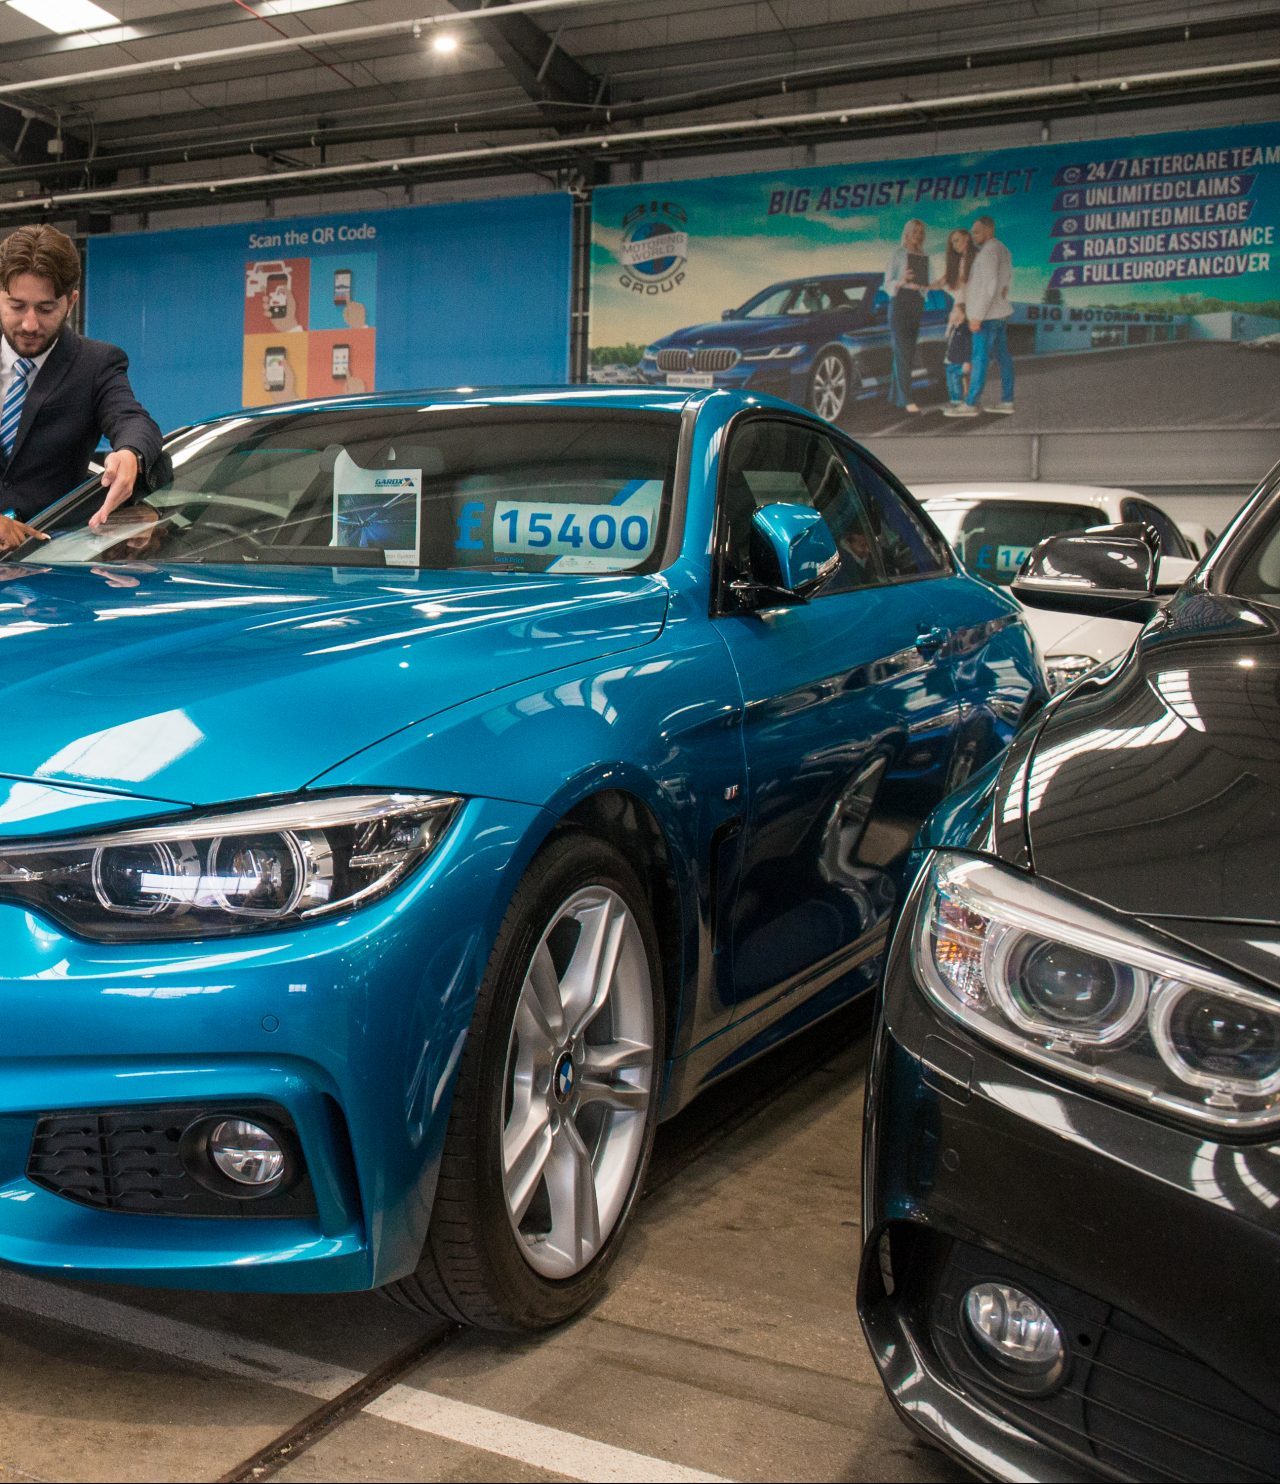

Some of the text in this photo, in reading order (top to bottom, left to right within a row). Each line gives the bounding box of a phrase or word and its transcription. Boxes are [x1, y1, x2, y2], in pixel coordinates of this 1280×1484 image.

[1086, 145, 1280, 181] 24/7 AFTERCARE TEAM
[767, 167, 1039, 215] BIG ASSIST PROTECT
[1085, 176, 1241, 207] UNLIMITED CLAIMS
[1084, 200, 1249, 232] UNLIMITED MILEAGE
[249, 223, 376, 249] Scan the QR Code
[1168, 226, 1274, 251] ASSISTANCE
[1083, 253, 1270, 282] FULL EUROPEAN COVER
[619, 271, 685, 295] GROUP
[1027, 305, 1062, 321] BIG
[1070, 308, 1140, 322] MOTORING
[500, 509, 649, 551] 15400
